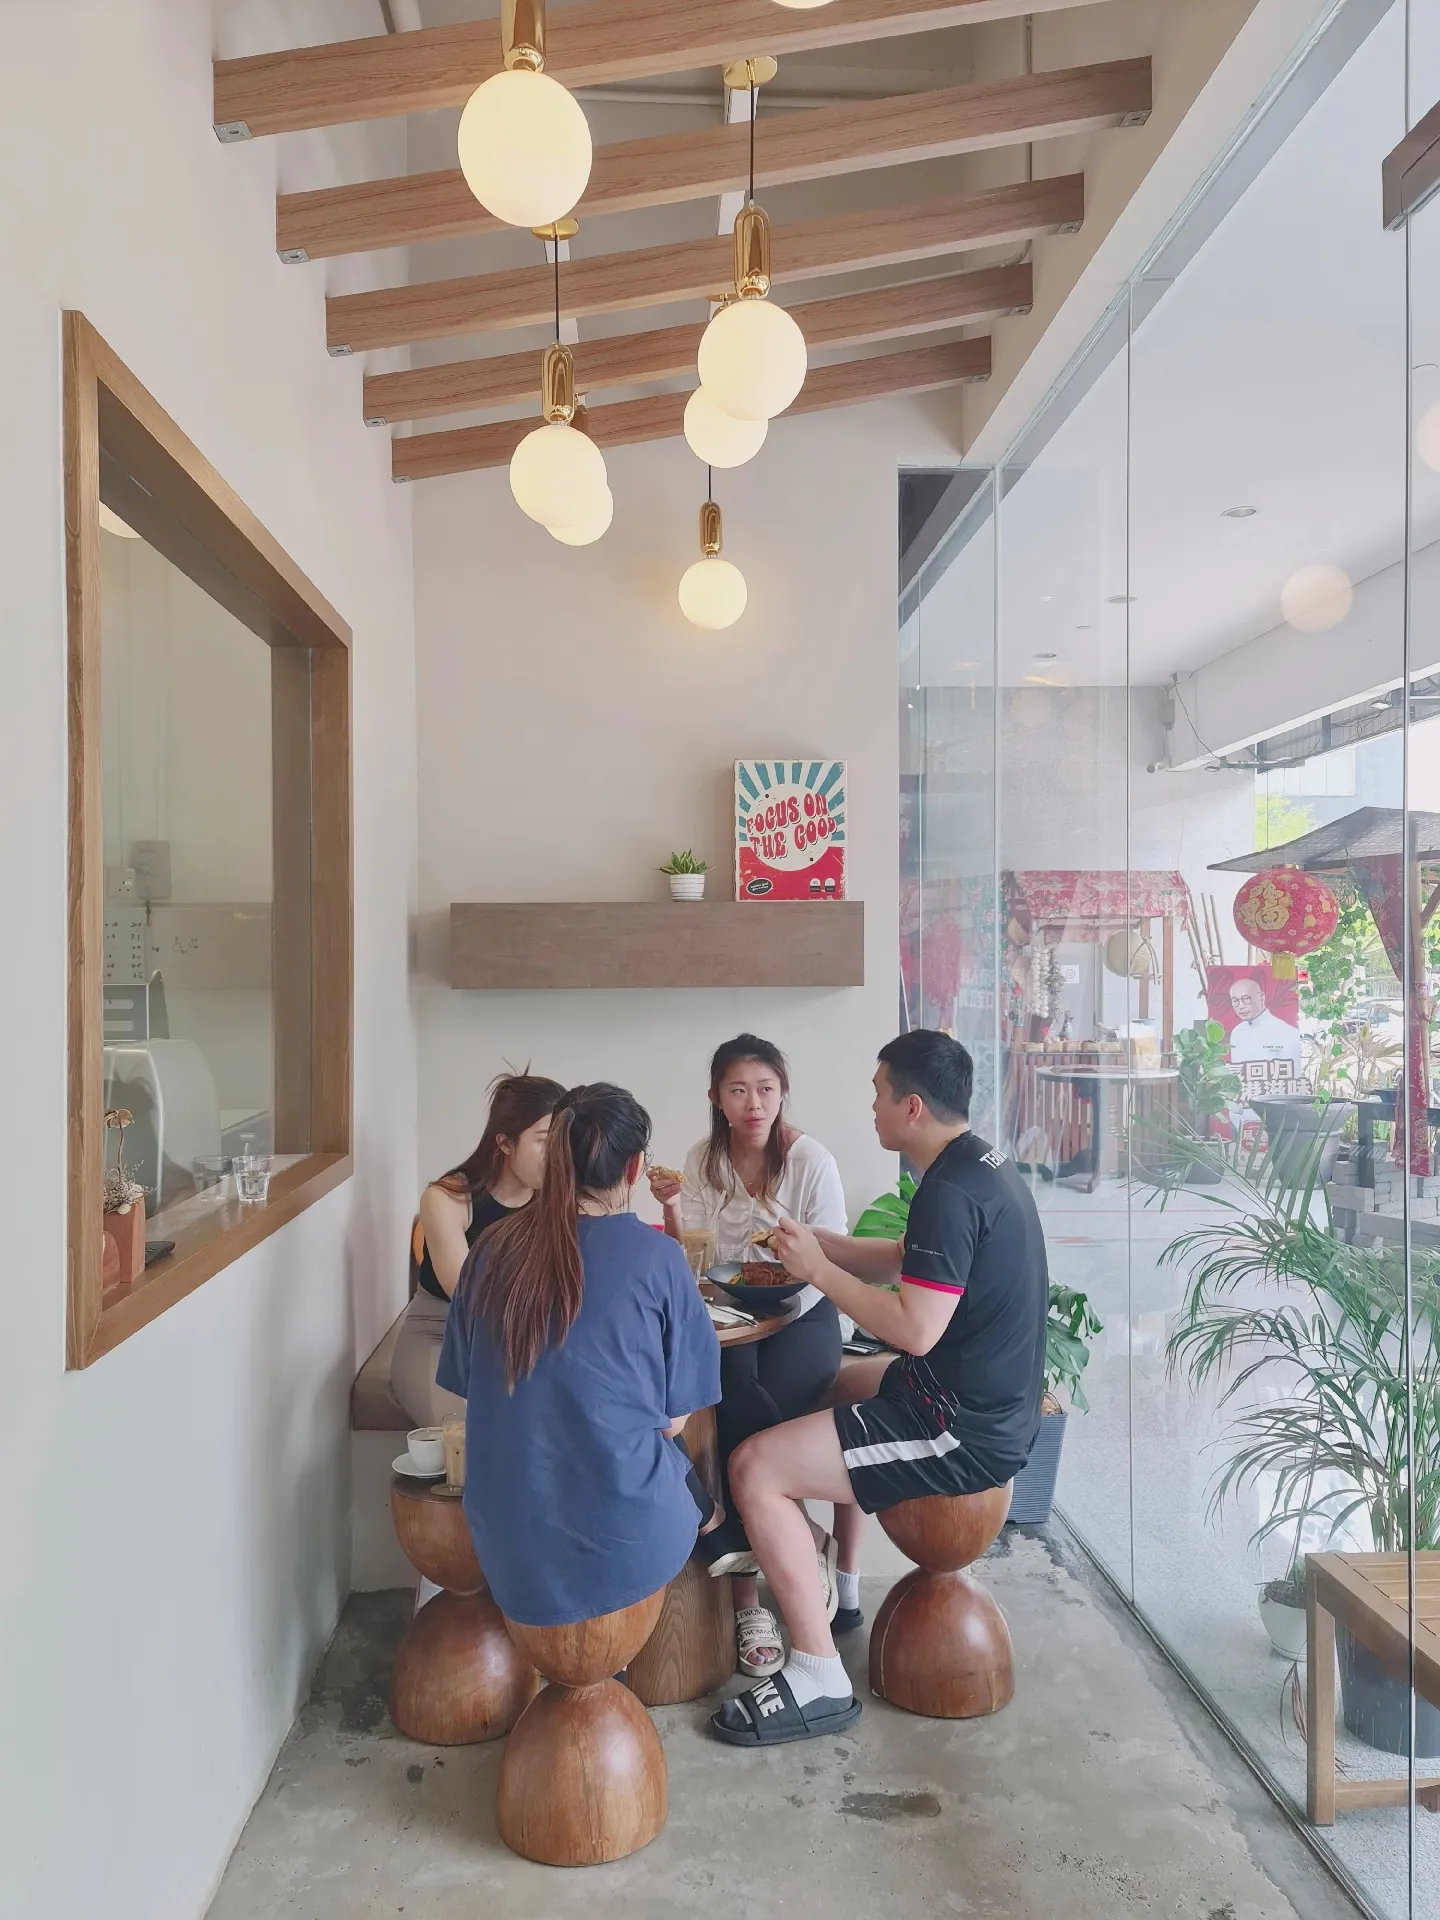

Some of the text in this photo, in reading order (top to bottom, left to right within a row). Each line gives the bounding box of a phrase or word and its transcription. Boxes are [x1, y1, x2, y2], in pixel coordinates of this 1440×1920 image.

[746, 793, 828, 834] FOCUS ON
[749, 817, 838, 858] THE GOOD
